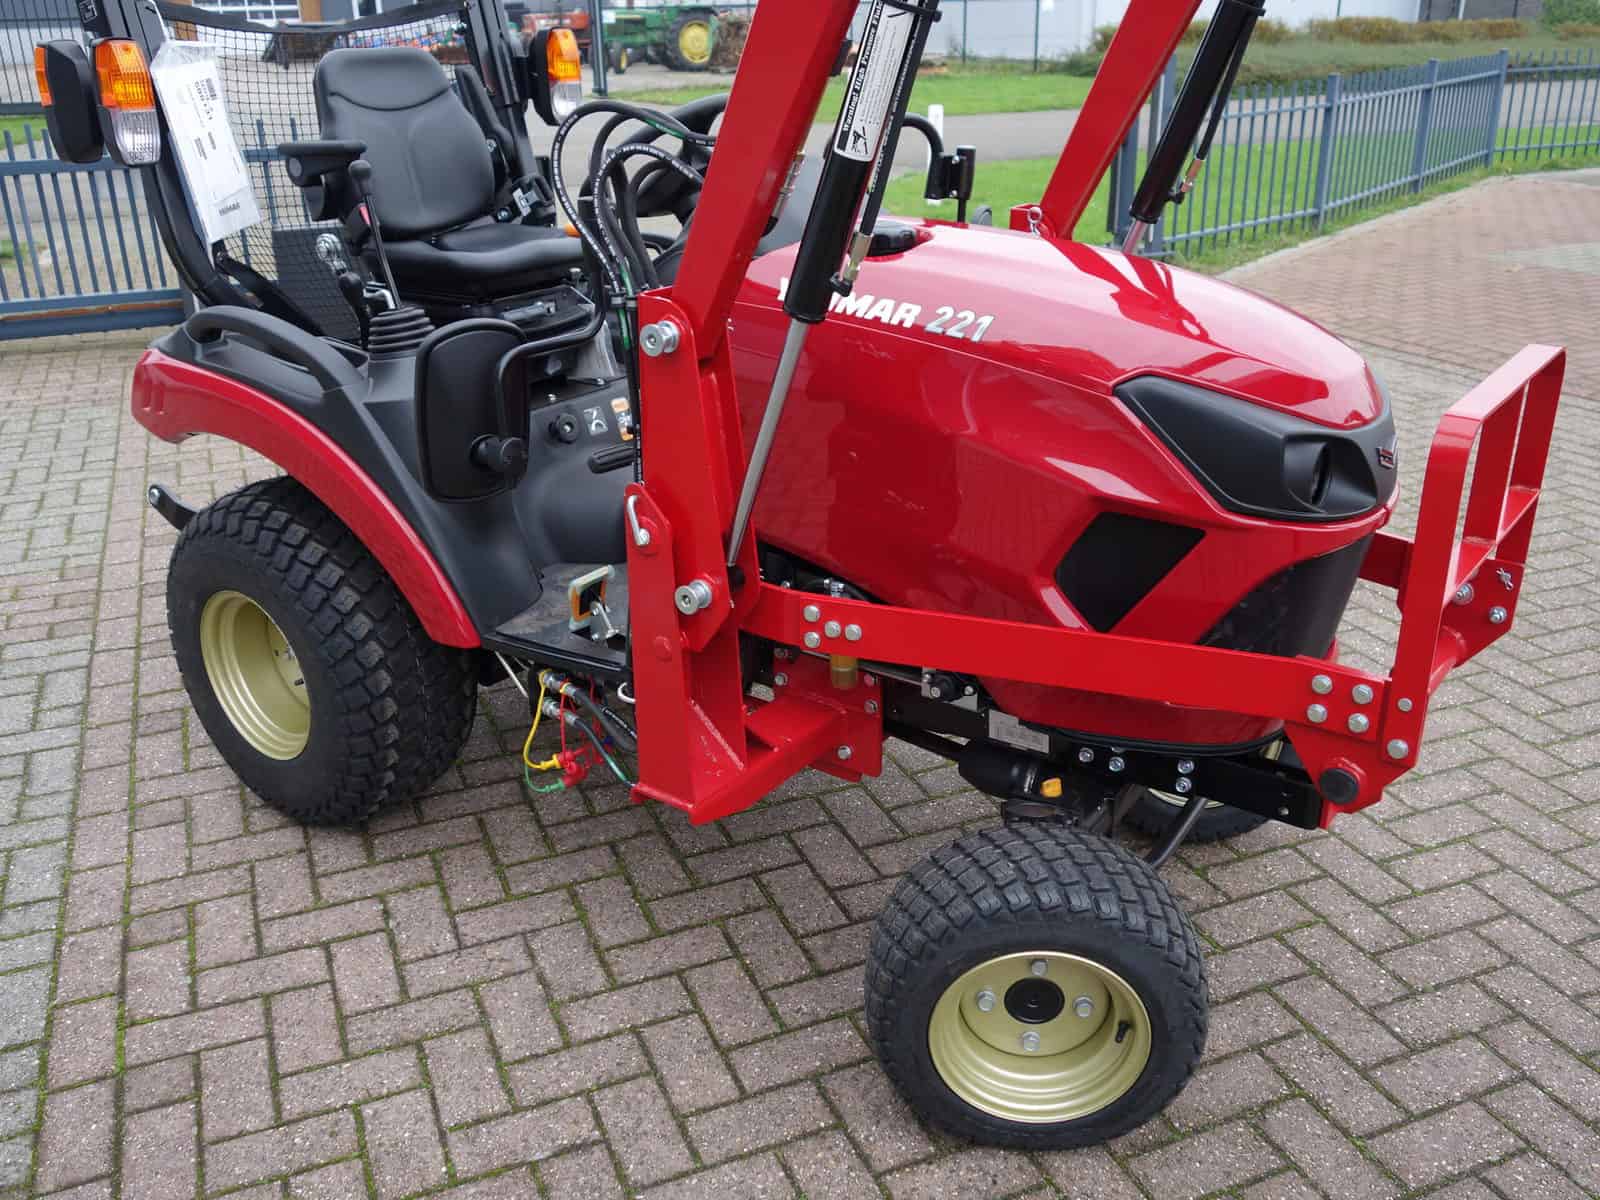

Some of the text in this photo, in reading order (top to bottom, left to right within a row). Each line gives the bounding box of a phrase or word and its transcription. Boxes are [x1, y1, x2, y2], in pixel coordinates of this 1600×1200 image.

[854, 67, 865, 91] High
[777, 276, 995, 343] MAR 221
